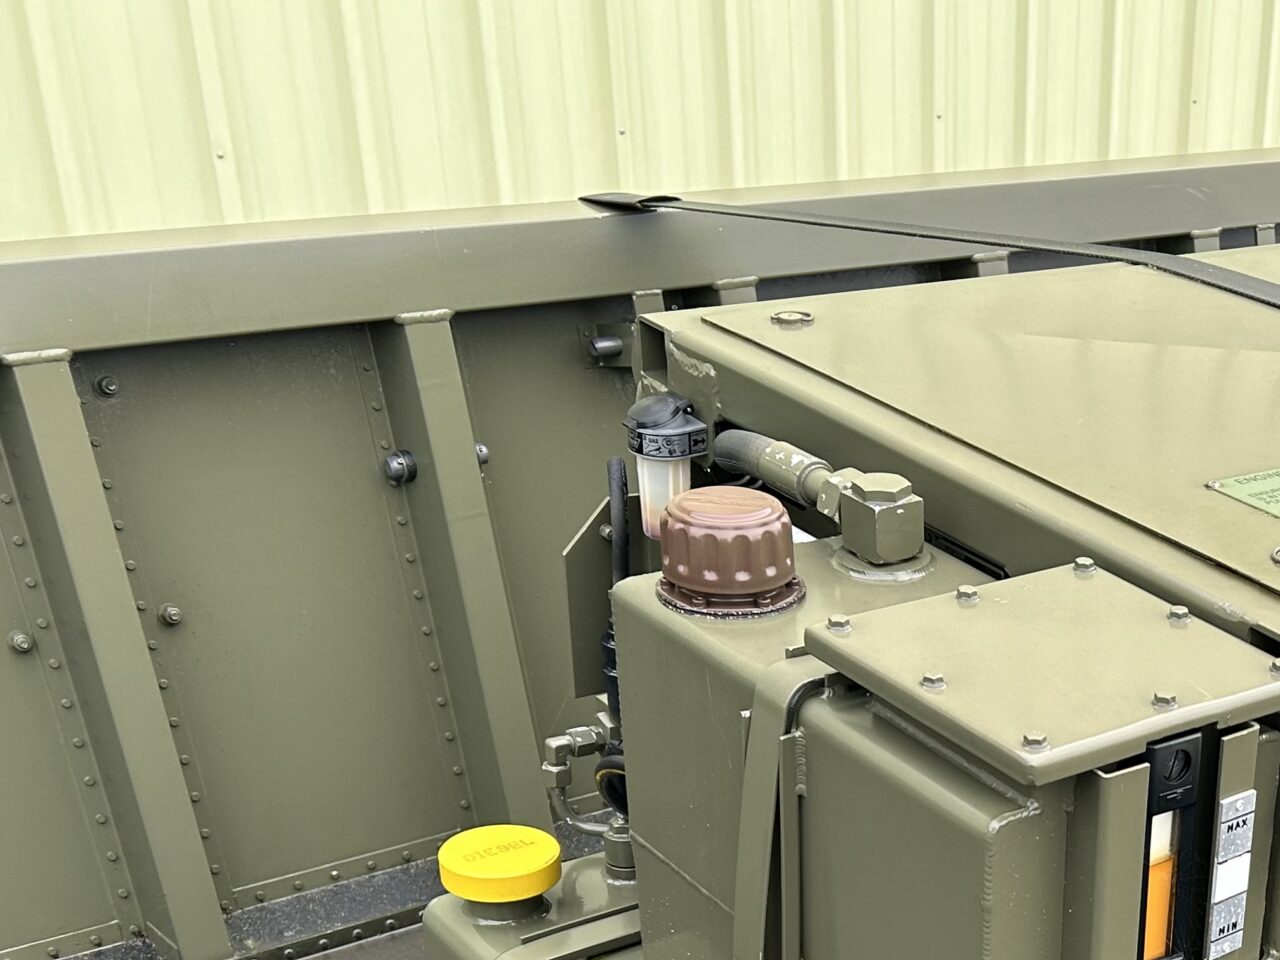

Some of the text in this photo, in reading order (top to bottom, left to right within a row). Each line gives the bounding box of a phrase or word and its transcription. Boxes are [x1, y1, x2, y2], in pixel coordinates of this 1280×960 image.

[1226, 818, 1248, 834] MAX
[462, 839, 534, 862] DIESEL
[1218, 920, 1238, 937] MIN
